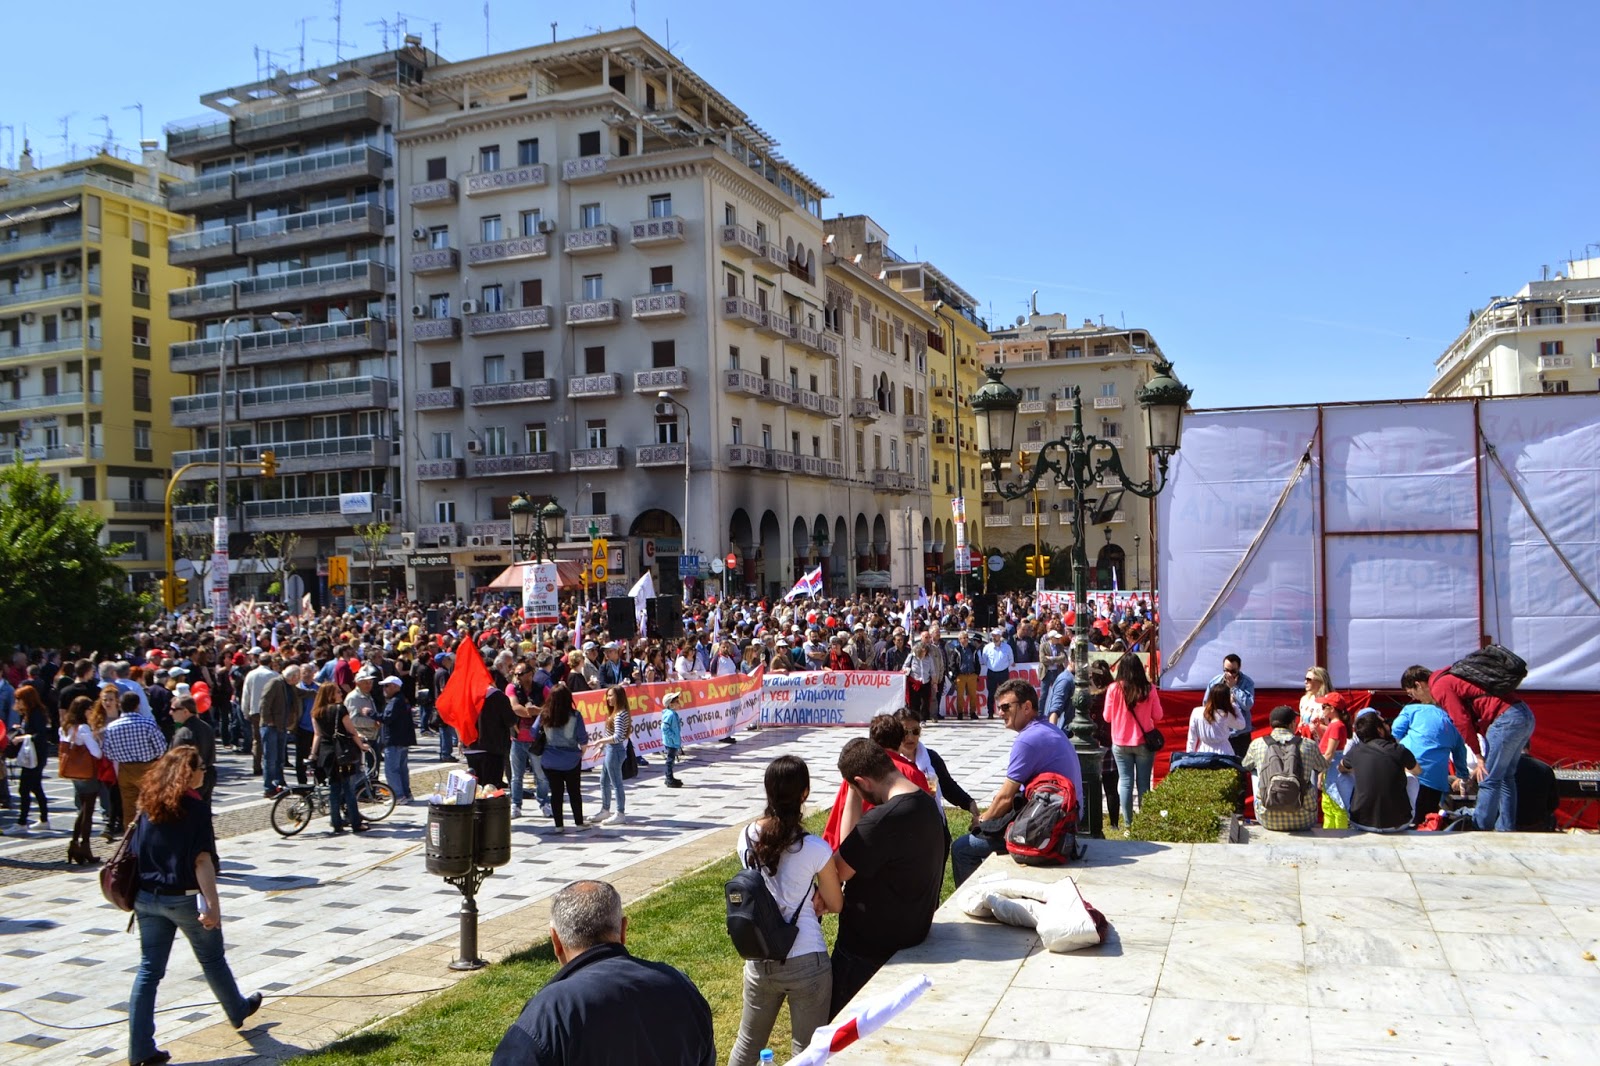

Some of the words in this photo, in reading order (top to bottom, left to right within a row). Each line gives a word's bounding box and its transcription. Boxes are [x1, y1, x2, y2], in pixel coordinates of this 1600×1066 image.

[805, 673, 818, 685] δε
[823, 672, 837, 686] θα
[795, 686, 846, 703] μνημόνια
[575, 693, 649, 723] Αγώας
[775, 708, 845, 724] ΚΑΛΑΜΑΡΙΑΣ
